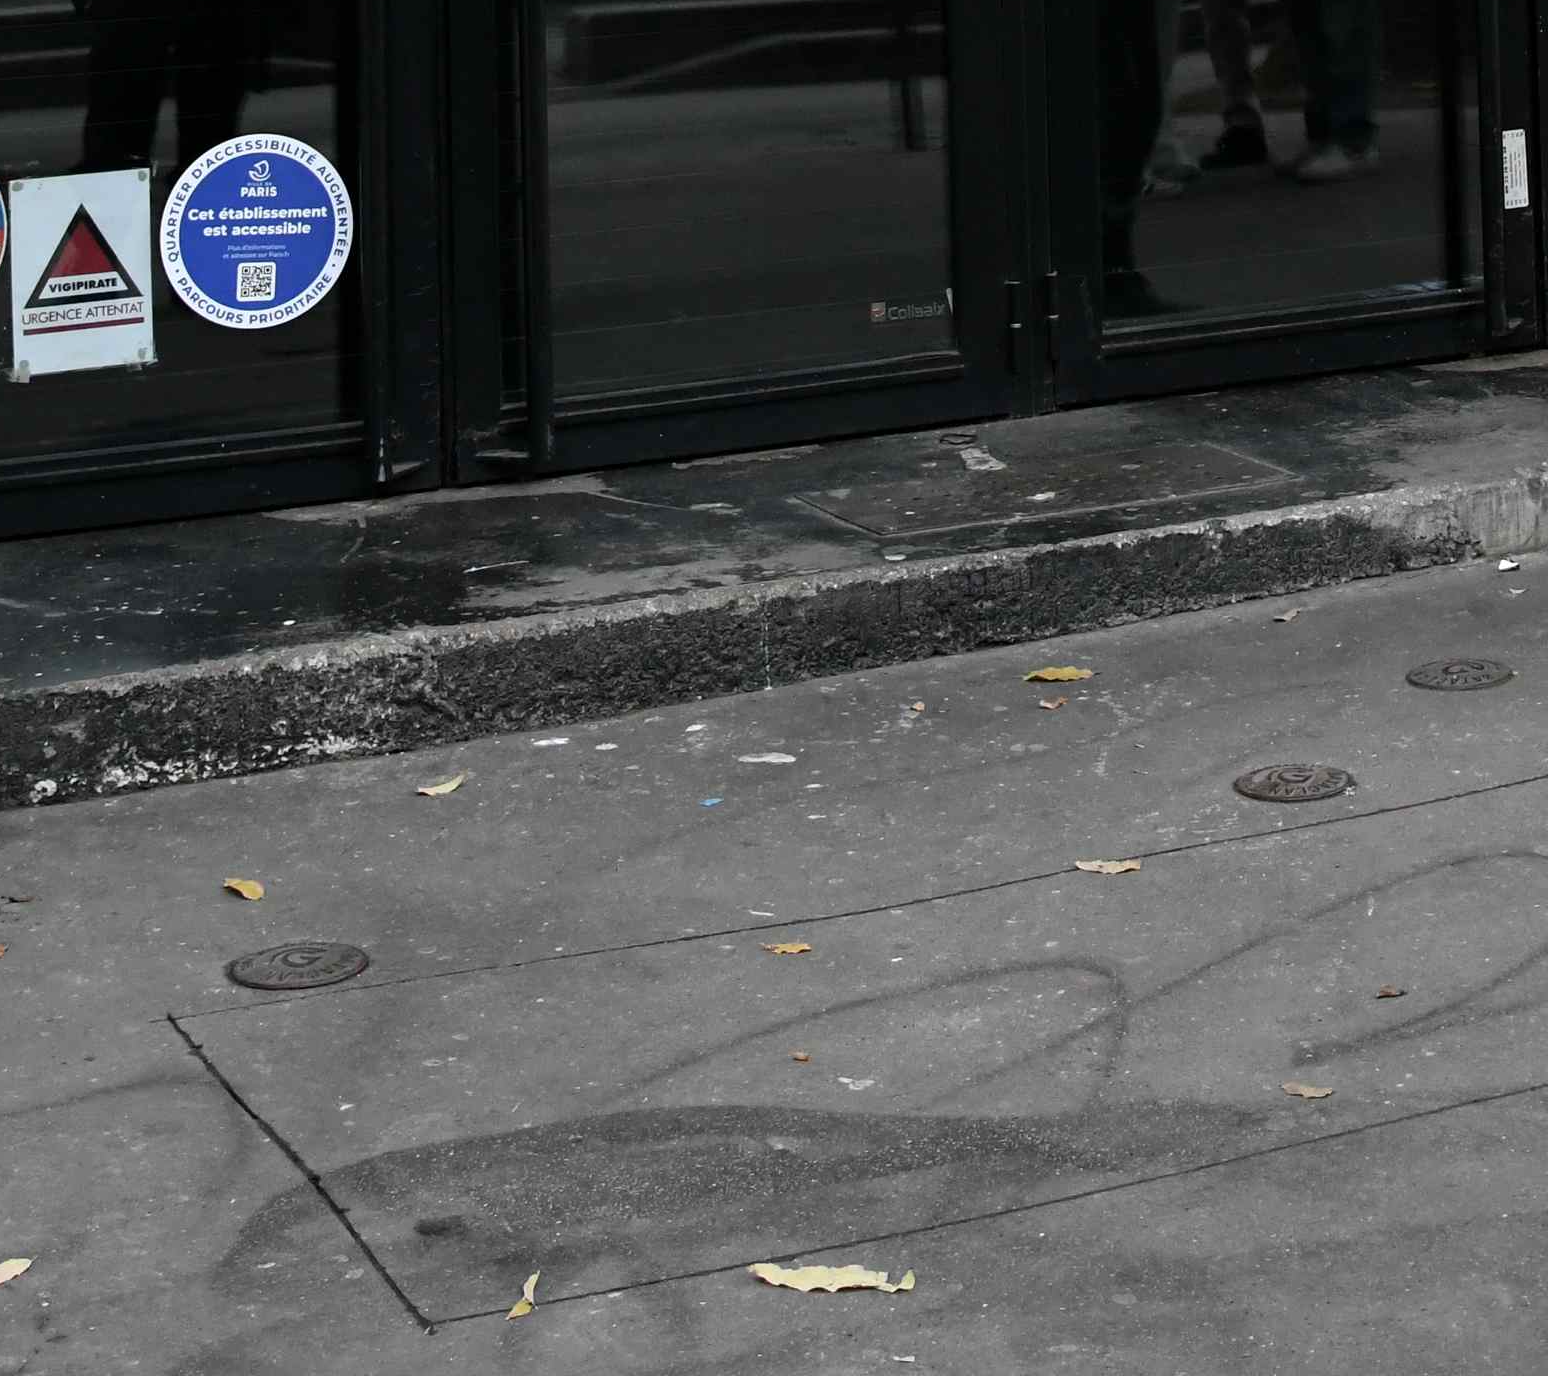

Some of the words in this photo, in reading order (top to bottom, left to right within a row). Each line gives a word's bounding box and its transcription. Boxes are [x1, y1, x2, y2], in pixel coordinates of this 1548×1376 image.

[240, 186, 277, 198] PARIS
[166, 183, 192, 263] QUARTIER
[192, 139, 319, 180] D'ACCESSIBILITÉ
[316, 166, 350, 258] AUGMENTÉE
[188, 208, 214, 221] Cet
[219, 206, 328, 220] établissement
[203, 224, 228, 237] est
[231, 221, 312, 237] accessible
[49, 278, 117, 293] VIGIPIRATE
[177, 276, 244, 324] PARCOURS
[249, 274, 332, 324] PRIORITAIRE
[21, 307, 83, 325] URGENCE
[85, 301, 145, 319] ATTENTAT
